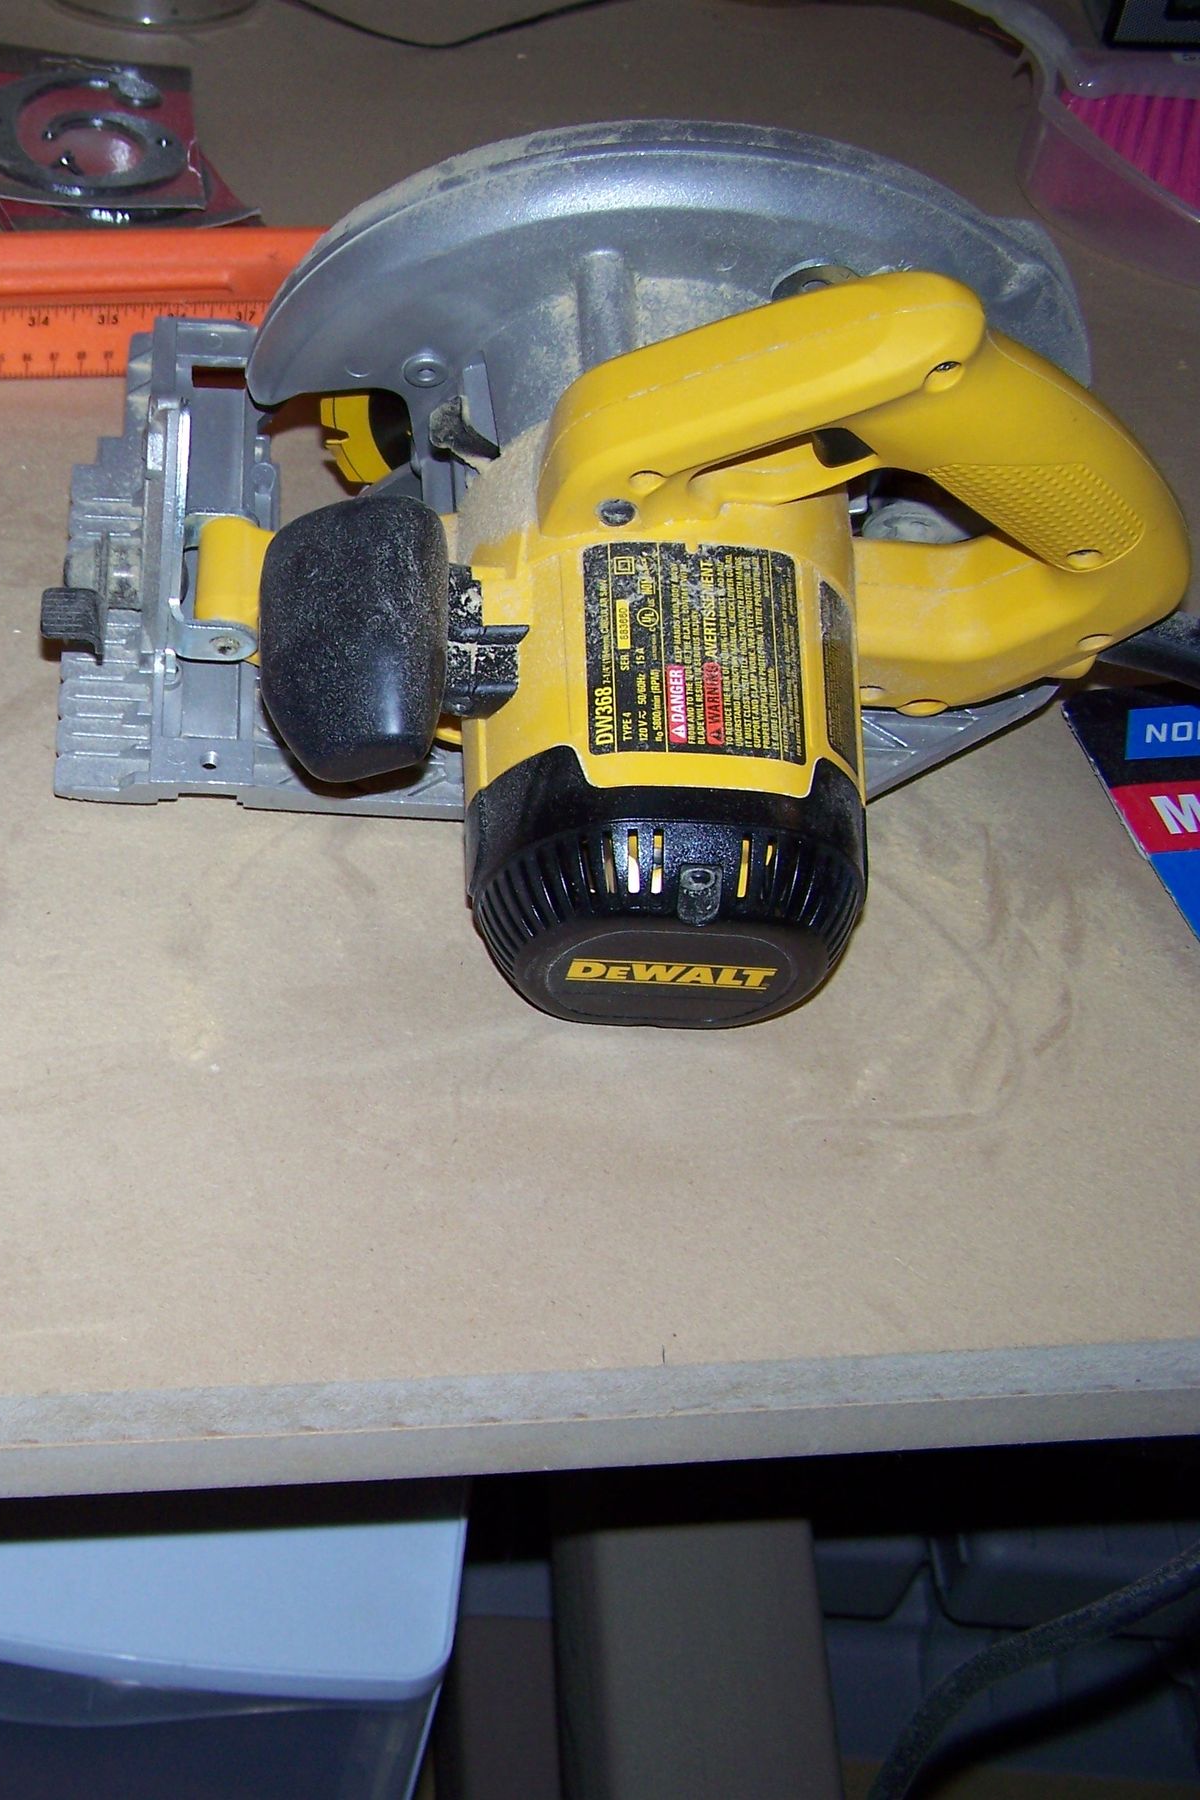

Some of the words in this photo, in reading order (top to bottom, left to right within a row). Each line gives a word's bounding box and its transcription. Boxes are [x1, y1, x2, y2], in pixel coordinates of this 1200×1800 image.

[700, 560, 717, 658] AVERTISSEMENT
[635, 655, 645, 664] 15
[636, 673, 647, 704] 50/60Hz
[669, 670, 684, 723] DANGER
[687, 697, 694, 705] TO
[695, 678, 703, 702] RESULT
[706, 666, 720, 724] WARNING
[595, 687, 613, 745] DW368
[696, 704, 704, 720] WILL
[724, 708, 733, 735] REDUCE
[733, 701, 743, 746] UNDERSTAND
[622, 719, 632, 741] TYPE
[639, 728, 648, 741] 120
[697, 722, 705, 744] BLADE
[752, 717, 761, 748] SUPPORT
[762, 722, 771, 749] PROPER
[1145, 720, 1200, 744] NO
